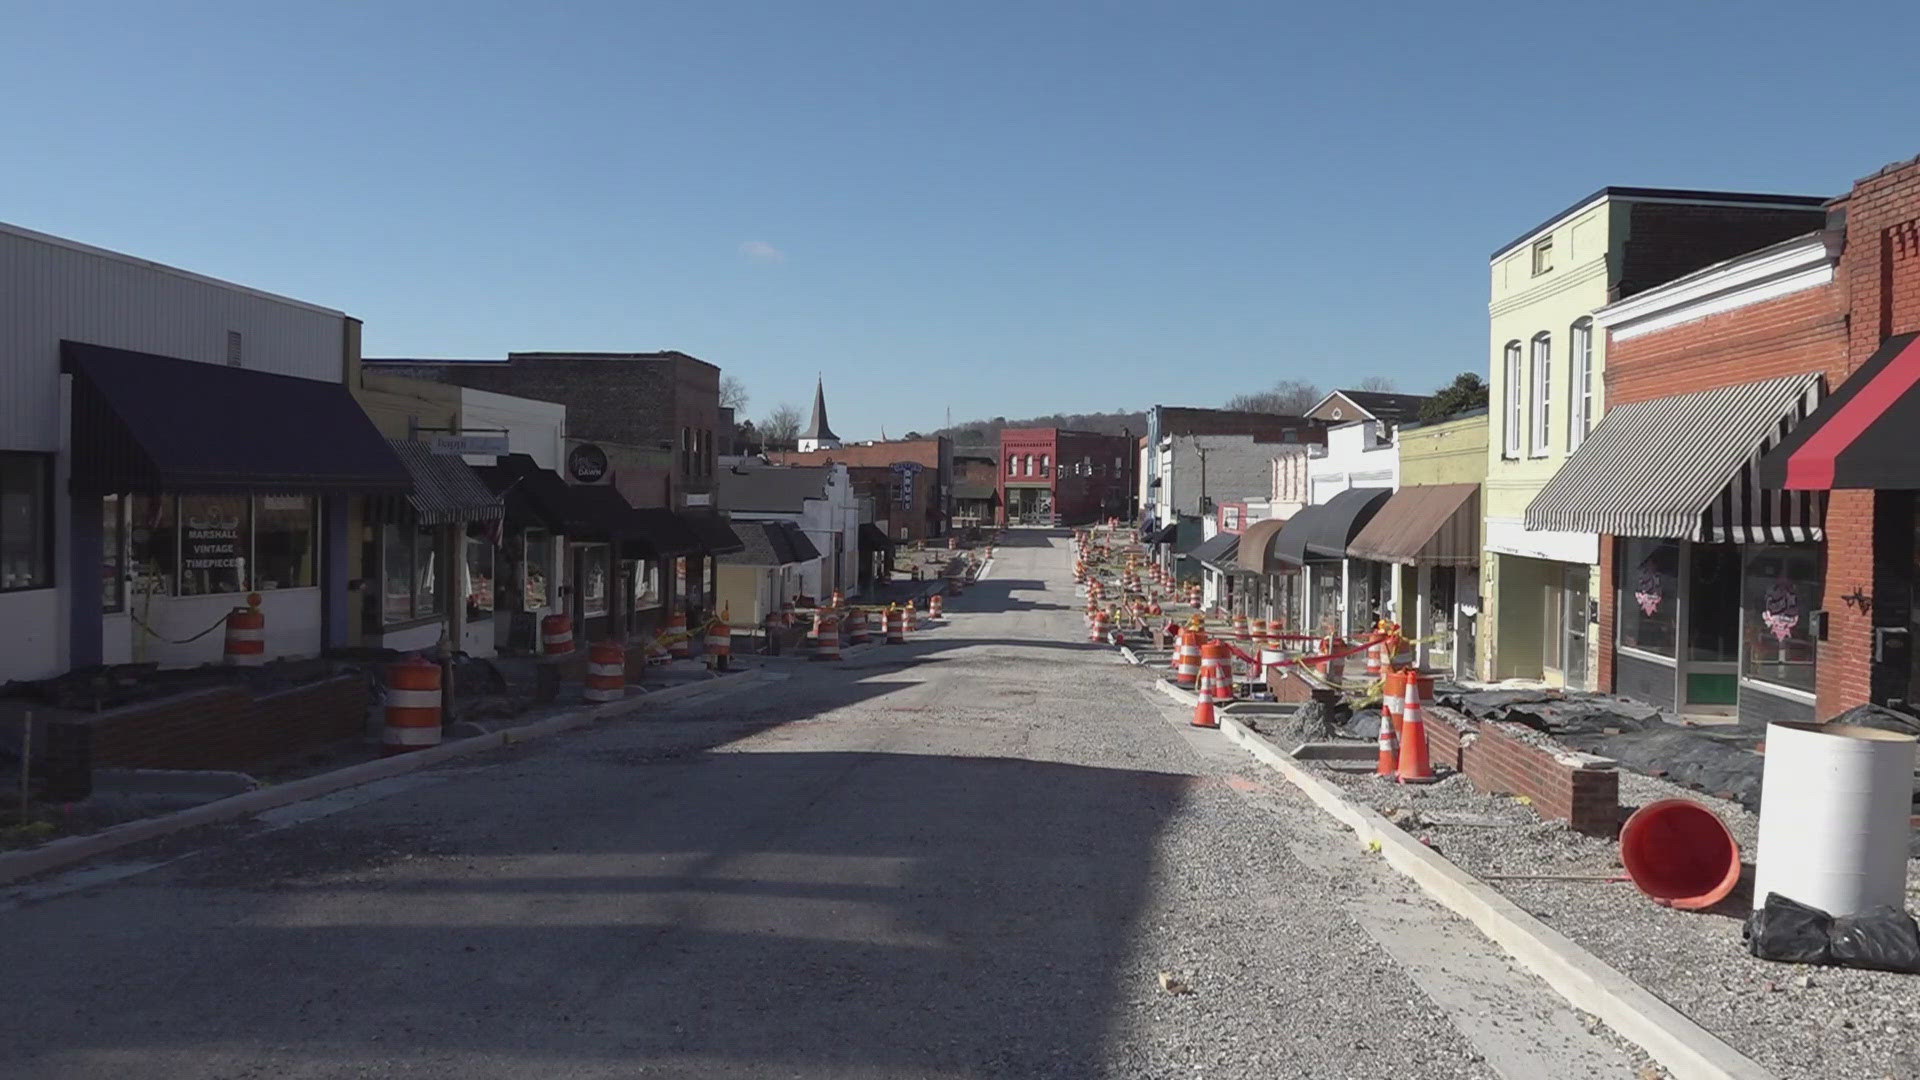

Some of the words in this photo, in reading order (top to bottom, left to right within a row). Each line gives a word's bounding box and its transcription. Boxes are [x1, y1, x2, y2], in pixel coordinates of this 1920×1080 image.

[188, 530, 238, 539] MARSHALL
[193, 544, 234, 554] VINTAGE
[186, 559, 241, 569] TIMEPIECES
